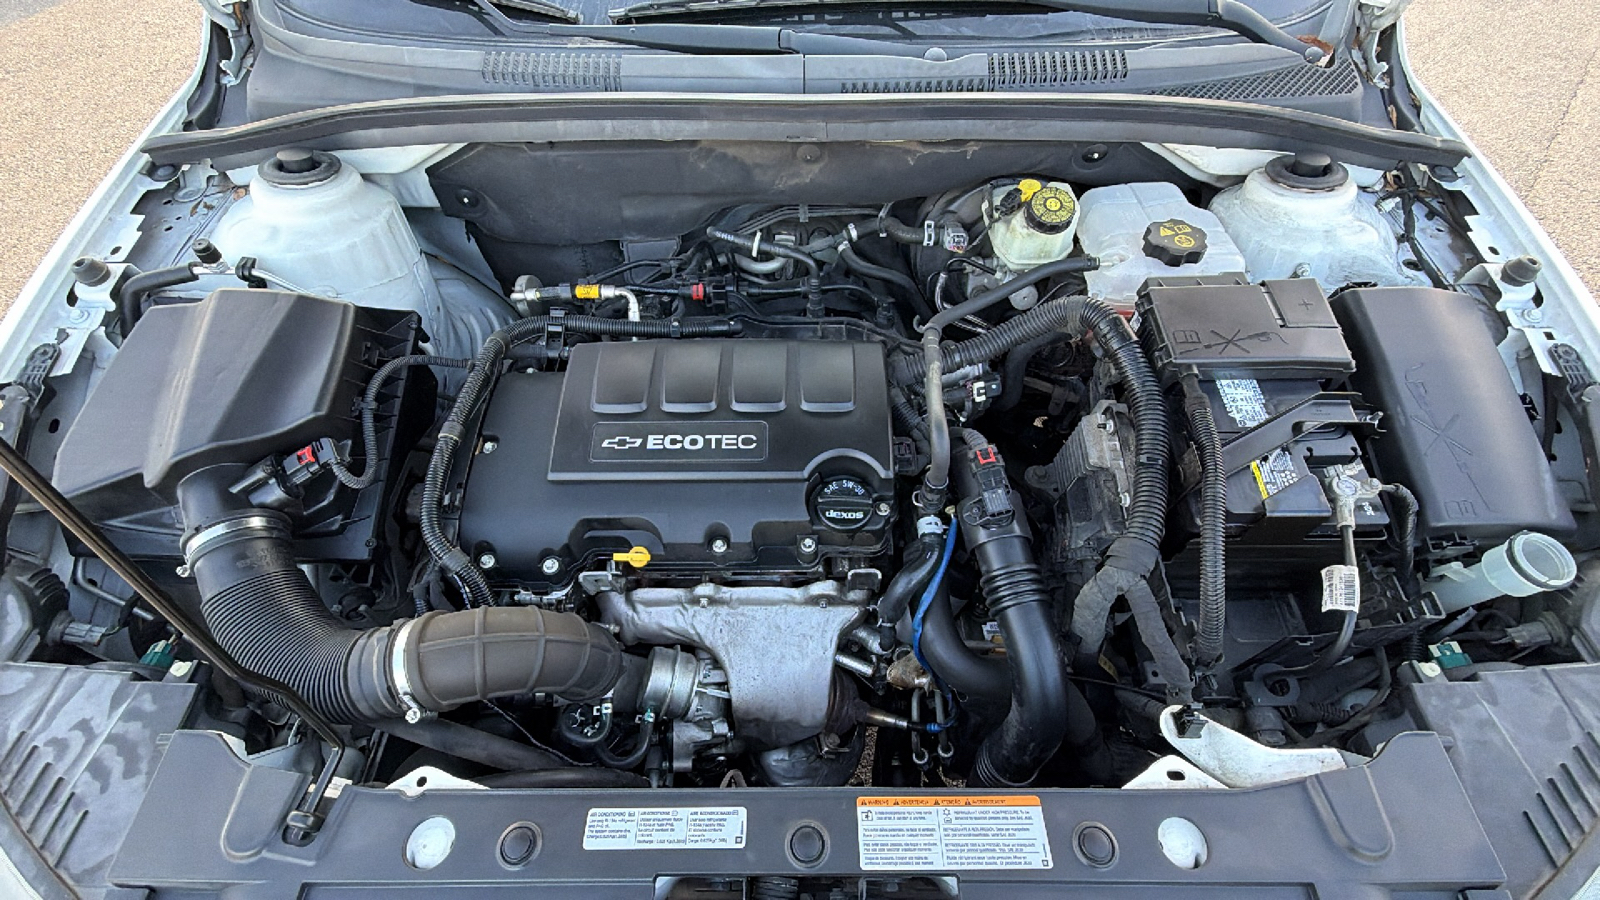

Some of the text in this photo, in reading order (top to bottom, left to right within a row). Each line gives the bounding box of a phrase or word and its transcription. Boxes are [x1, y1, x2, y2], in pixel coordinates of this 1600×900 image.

[646, 434, 757, 450] ECOTEC
[824, 479, 865, 496] SAE 5W-30
[825, 509, 864, 519] dexos
